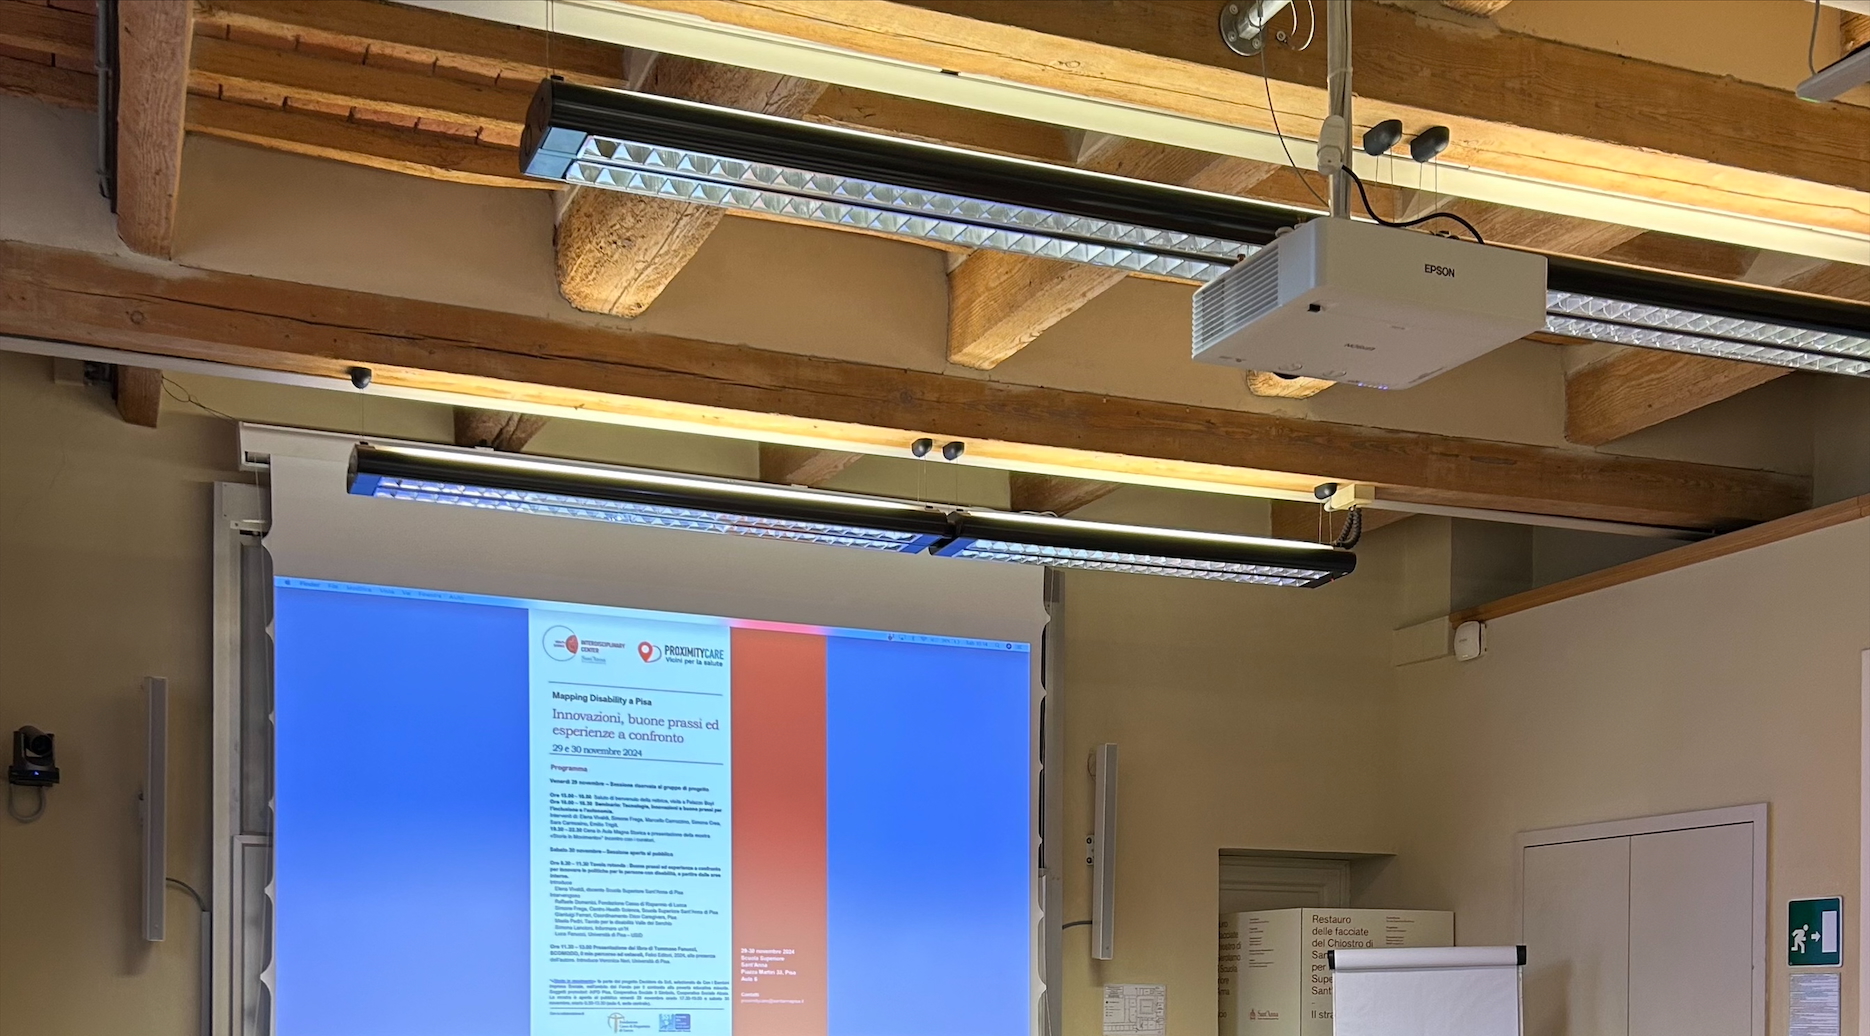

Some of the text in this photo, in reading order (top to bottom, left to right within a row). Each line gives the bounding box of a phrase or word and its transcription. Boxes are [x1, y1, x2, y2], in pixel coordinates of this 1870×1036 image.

[1424, 263, 1455, 278] EPSON
[581, 640, 625, 649] INTERDISCIPLINARY
[664, 645, 724, 660] PROXIMITYCARE
[666, 656, 683, 664] Vicini
[552, 692, 588, 703] Mapping
[590, 694, 627, 706] Disability
[635, 698, 652, 706] Pisa
[552, 708, 720, 730] Innovazioni, buone prassi ed
[552, 726, 684, 744] esperienze a confronto
[552, 744, 564, 752] 29
[571, 746, 582, 754] 30
[583, 746, 622, 756] novembre
[622, 748, 642, 756] 2024
[550, 764, 588, 772] Programma
[1312, 914, 1352, 924] Restauro
[1219, 930, 1238, 939] acciate
[1312, 926, 1369, 936] delle facciate
[1312, 938, 1374, 948] del Chiostro di
[1312, 963, 1326, 973] per
[1312, 974, 1332, 986] Supe
[1312, 986, 1333, 995] Sant'
[1312, 1010, 1334, 1019] Il stra
